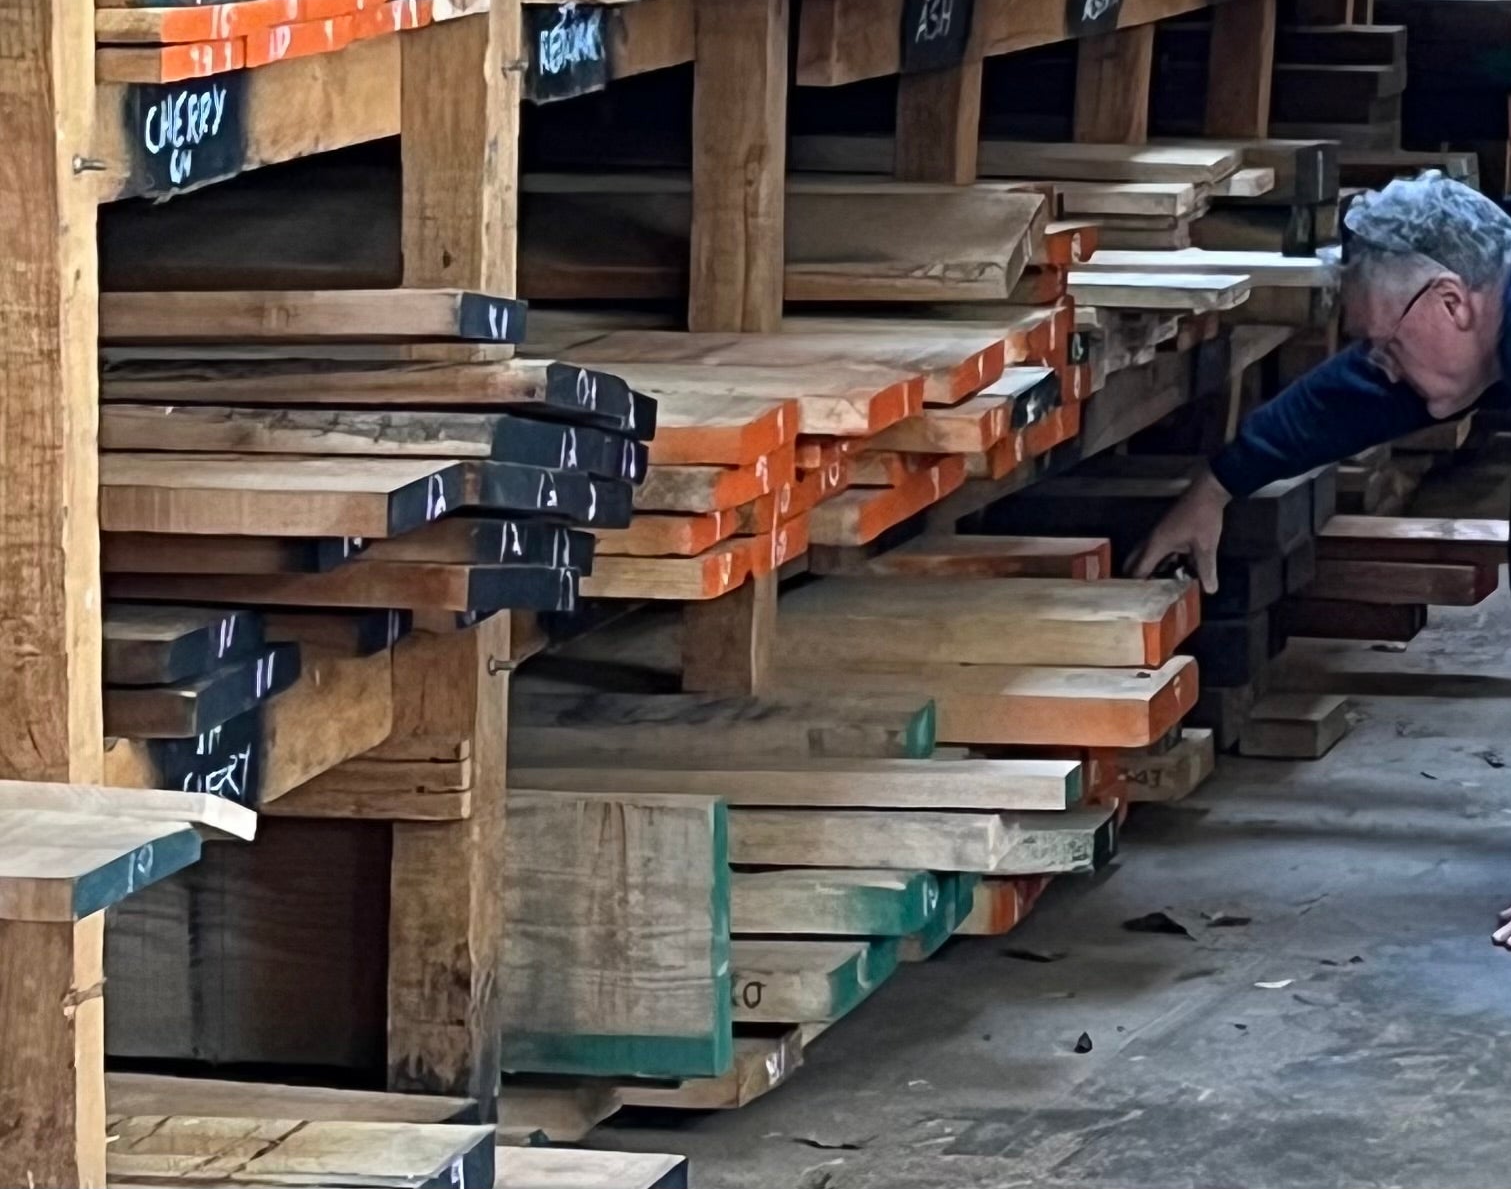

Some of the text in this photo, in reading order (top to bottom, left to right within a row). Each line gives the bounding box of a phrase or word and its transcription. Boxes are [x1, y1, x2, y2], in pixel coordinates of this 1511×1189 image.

[145, 83, 228, 155] CHERRY
[218, 614, 237, 659] 11
[256, 651, 276, 699] 11
